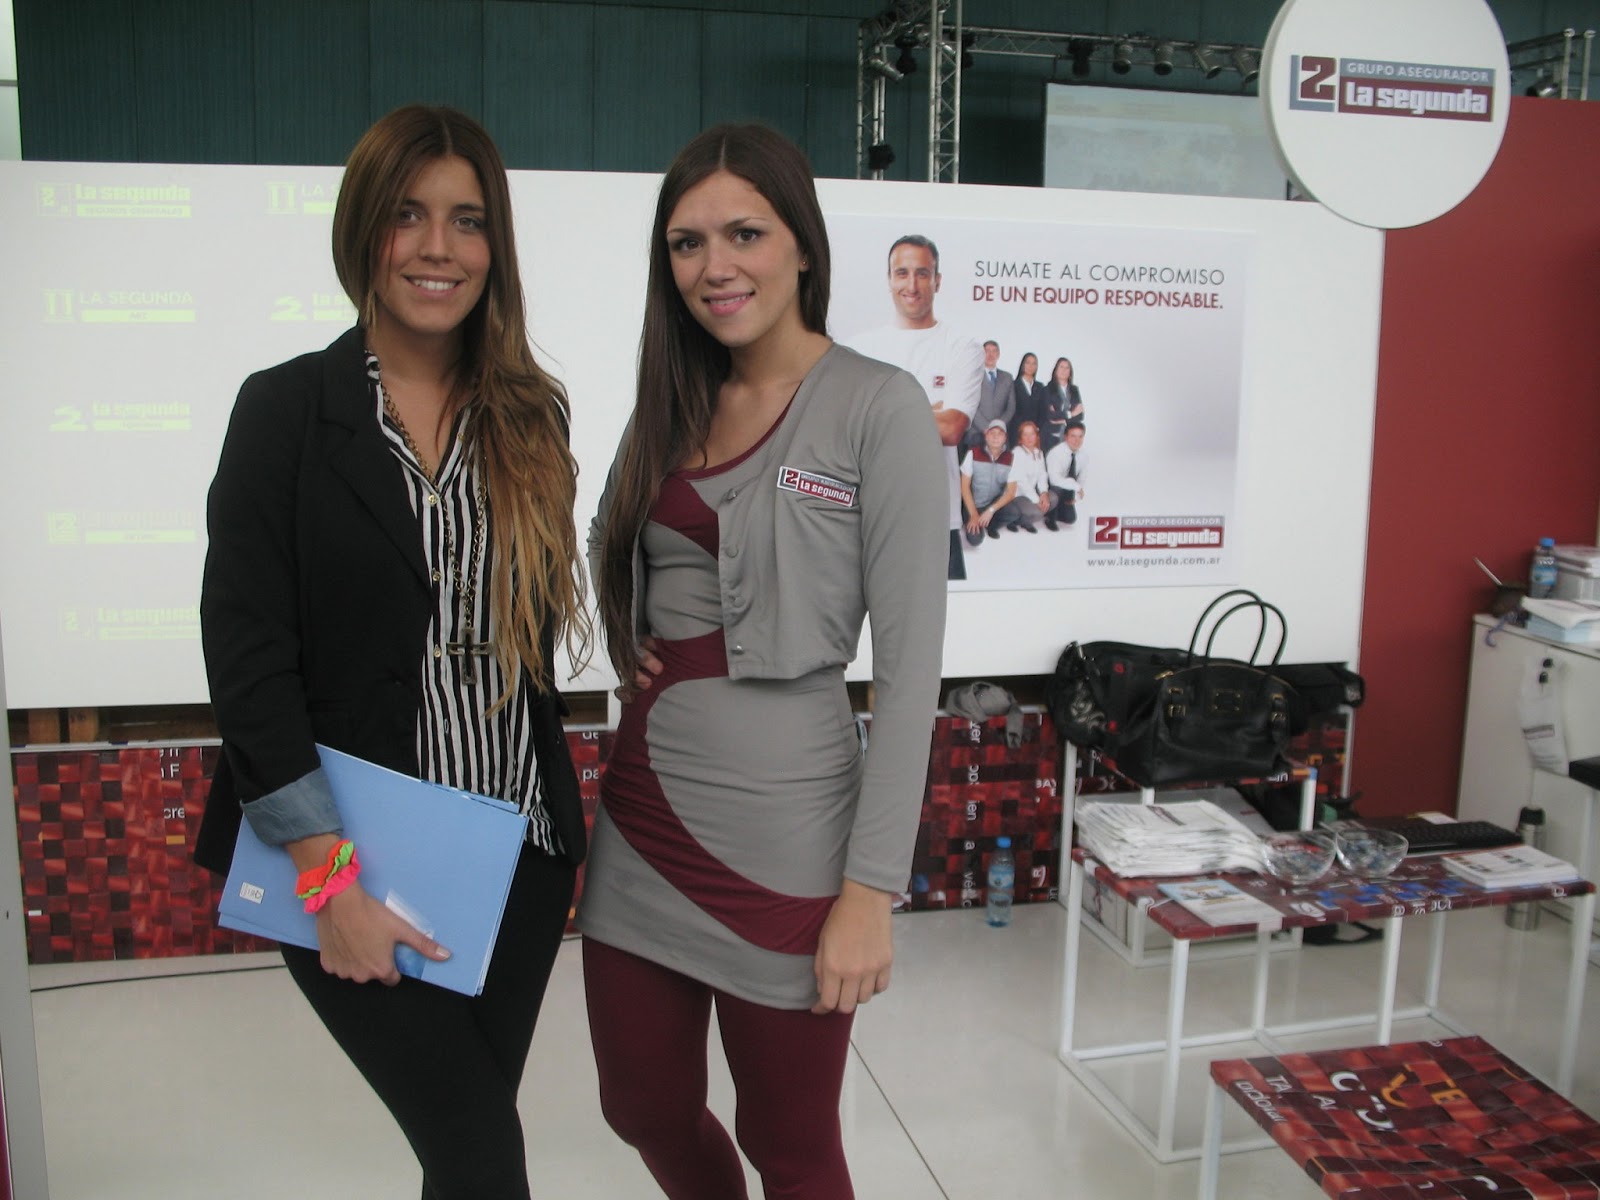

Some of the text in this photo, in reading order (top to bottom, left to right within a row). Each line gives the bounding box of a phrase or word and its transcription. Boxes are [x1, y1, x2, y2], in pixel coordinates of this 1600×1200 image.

[1346, 62, 1490, 82] GRUPO ASEGURADOR
[1345, 81, 1488, 115] La segunda
[974, 260, 1225, 286] SUMATE AL COMPROMISO
[107, 291, 194, 305] SEGUNDA
[973, 285, 1223, 310] DE UN EQUIPO RESPONSABLE.
[811, 483, 851, 503] segunda
[1125, 517, 1222, 526] GRUPO ASEGURADOR
[1124, 528, 1221, 548] La segunda
[1087, 555, 1221, 568] www.lasegunda.com.ar
